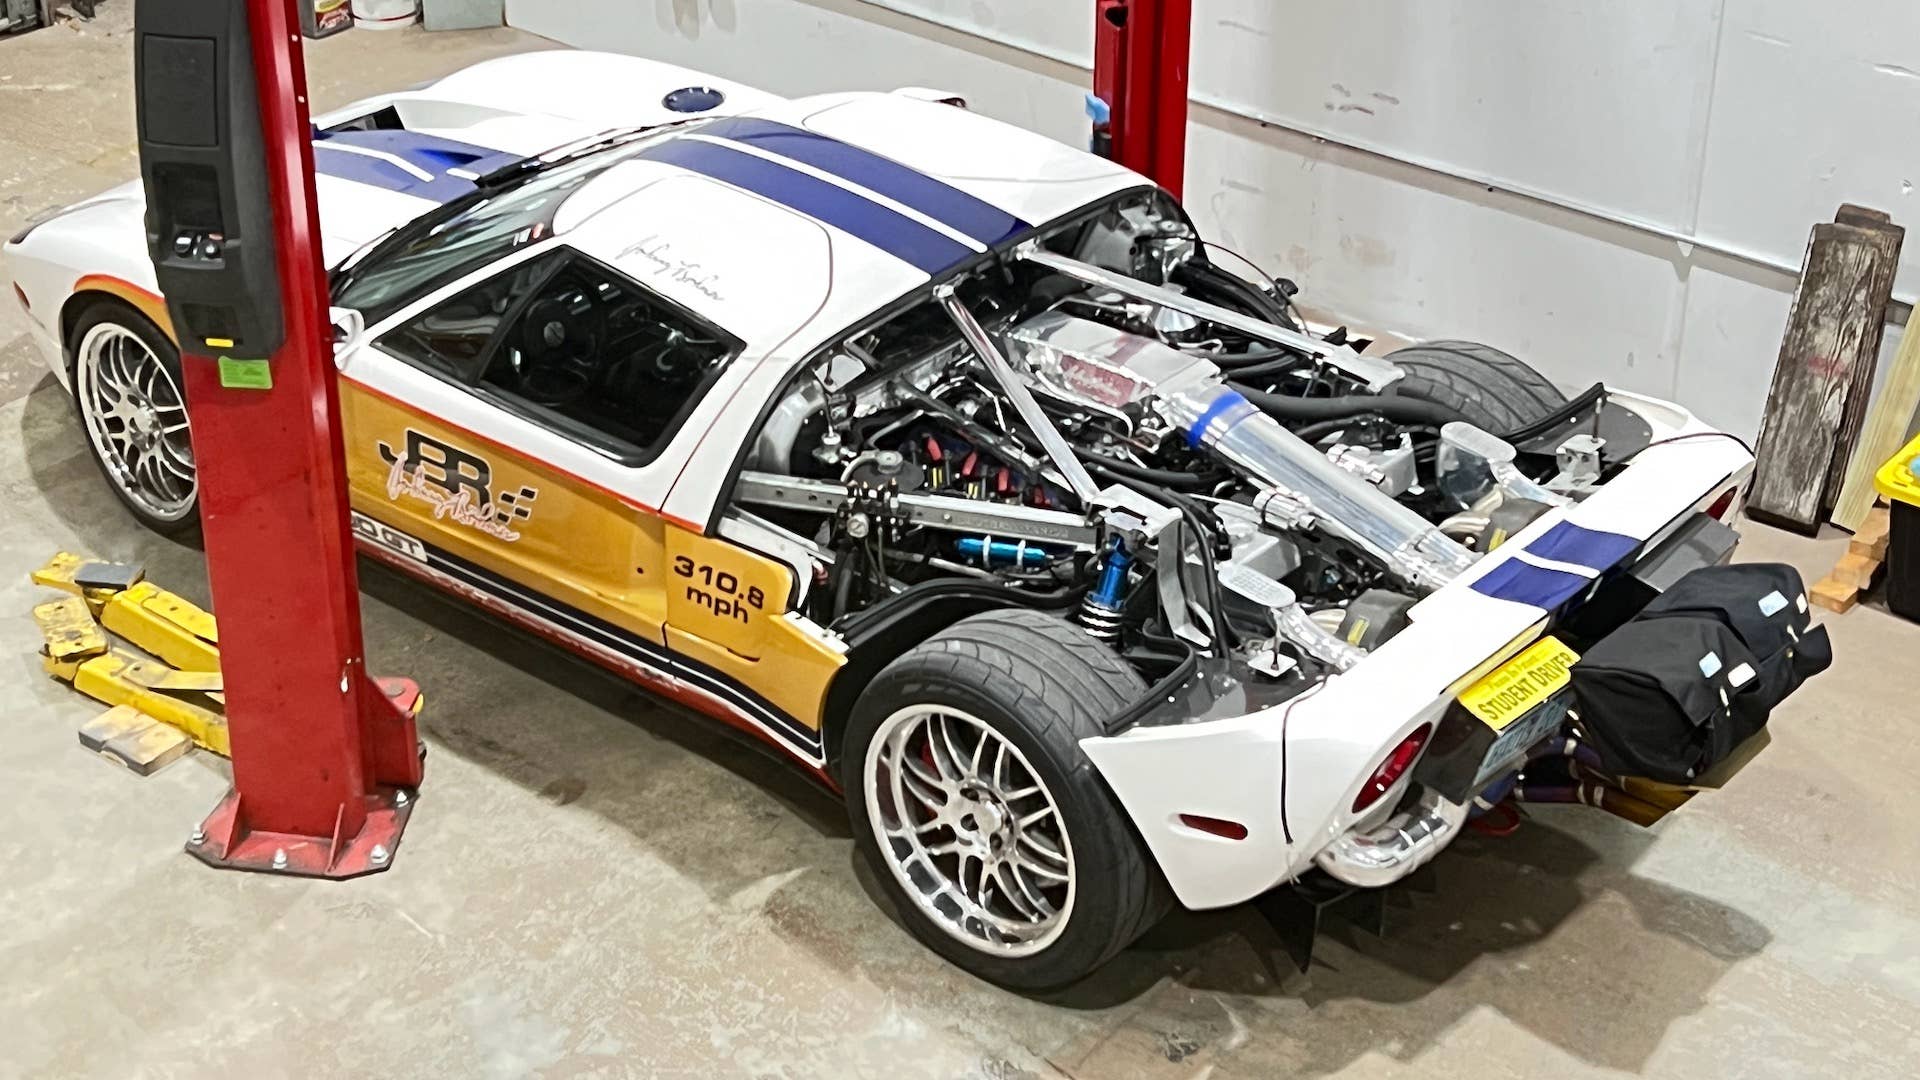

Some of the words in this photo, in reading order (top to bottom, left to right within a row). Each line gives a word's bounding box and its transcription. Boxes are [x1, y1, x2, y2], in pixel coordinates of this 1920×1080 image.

[674, 555, 764, 610] 310.8
[686, 586, 748, 624] mph
[1477, 677, 1539, 721] STUDENT
[1529, 652, 1573, 688] DRIVER
